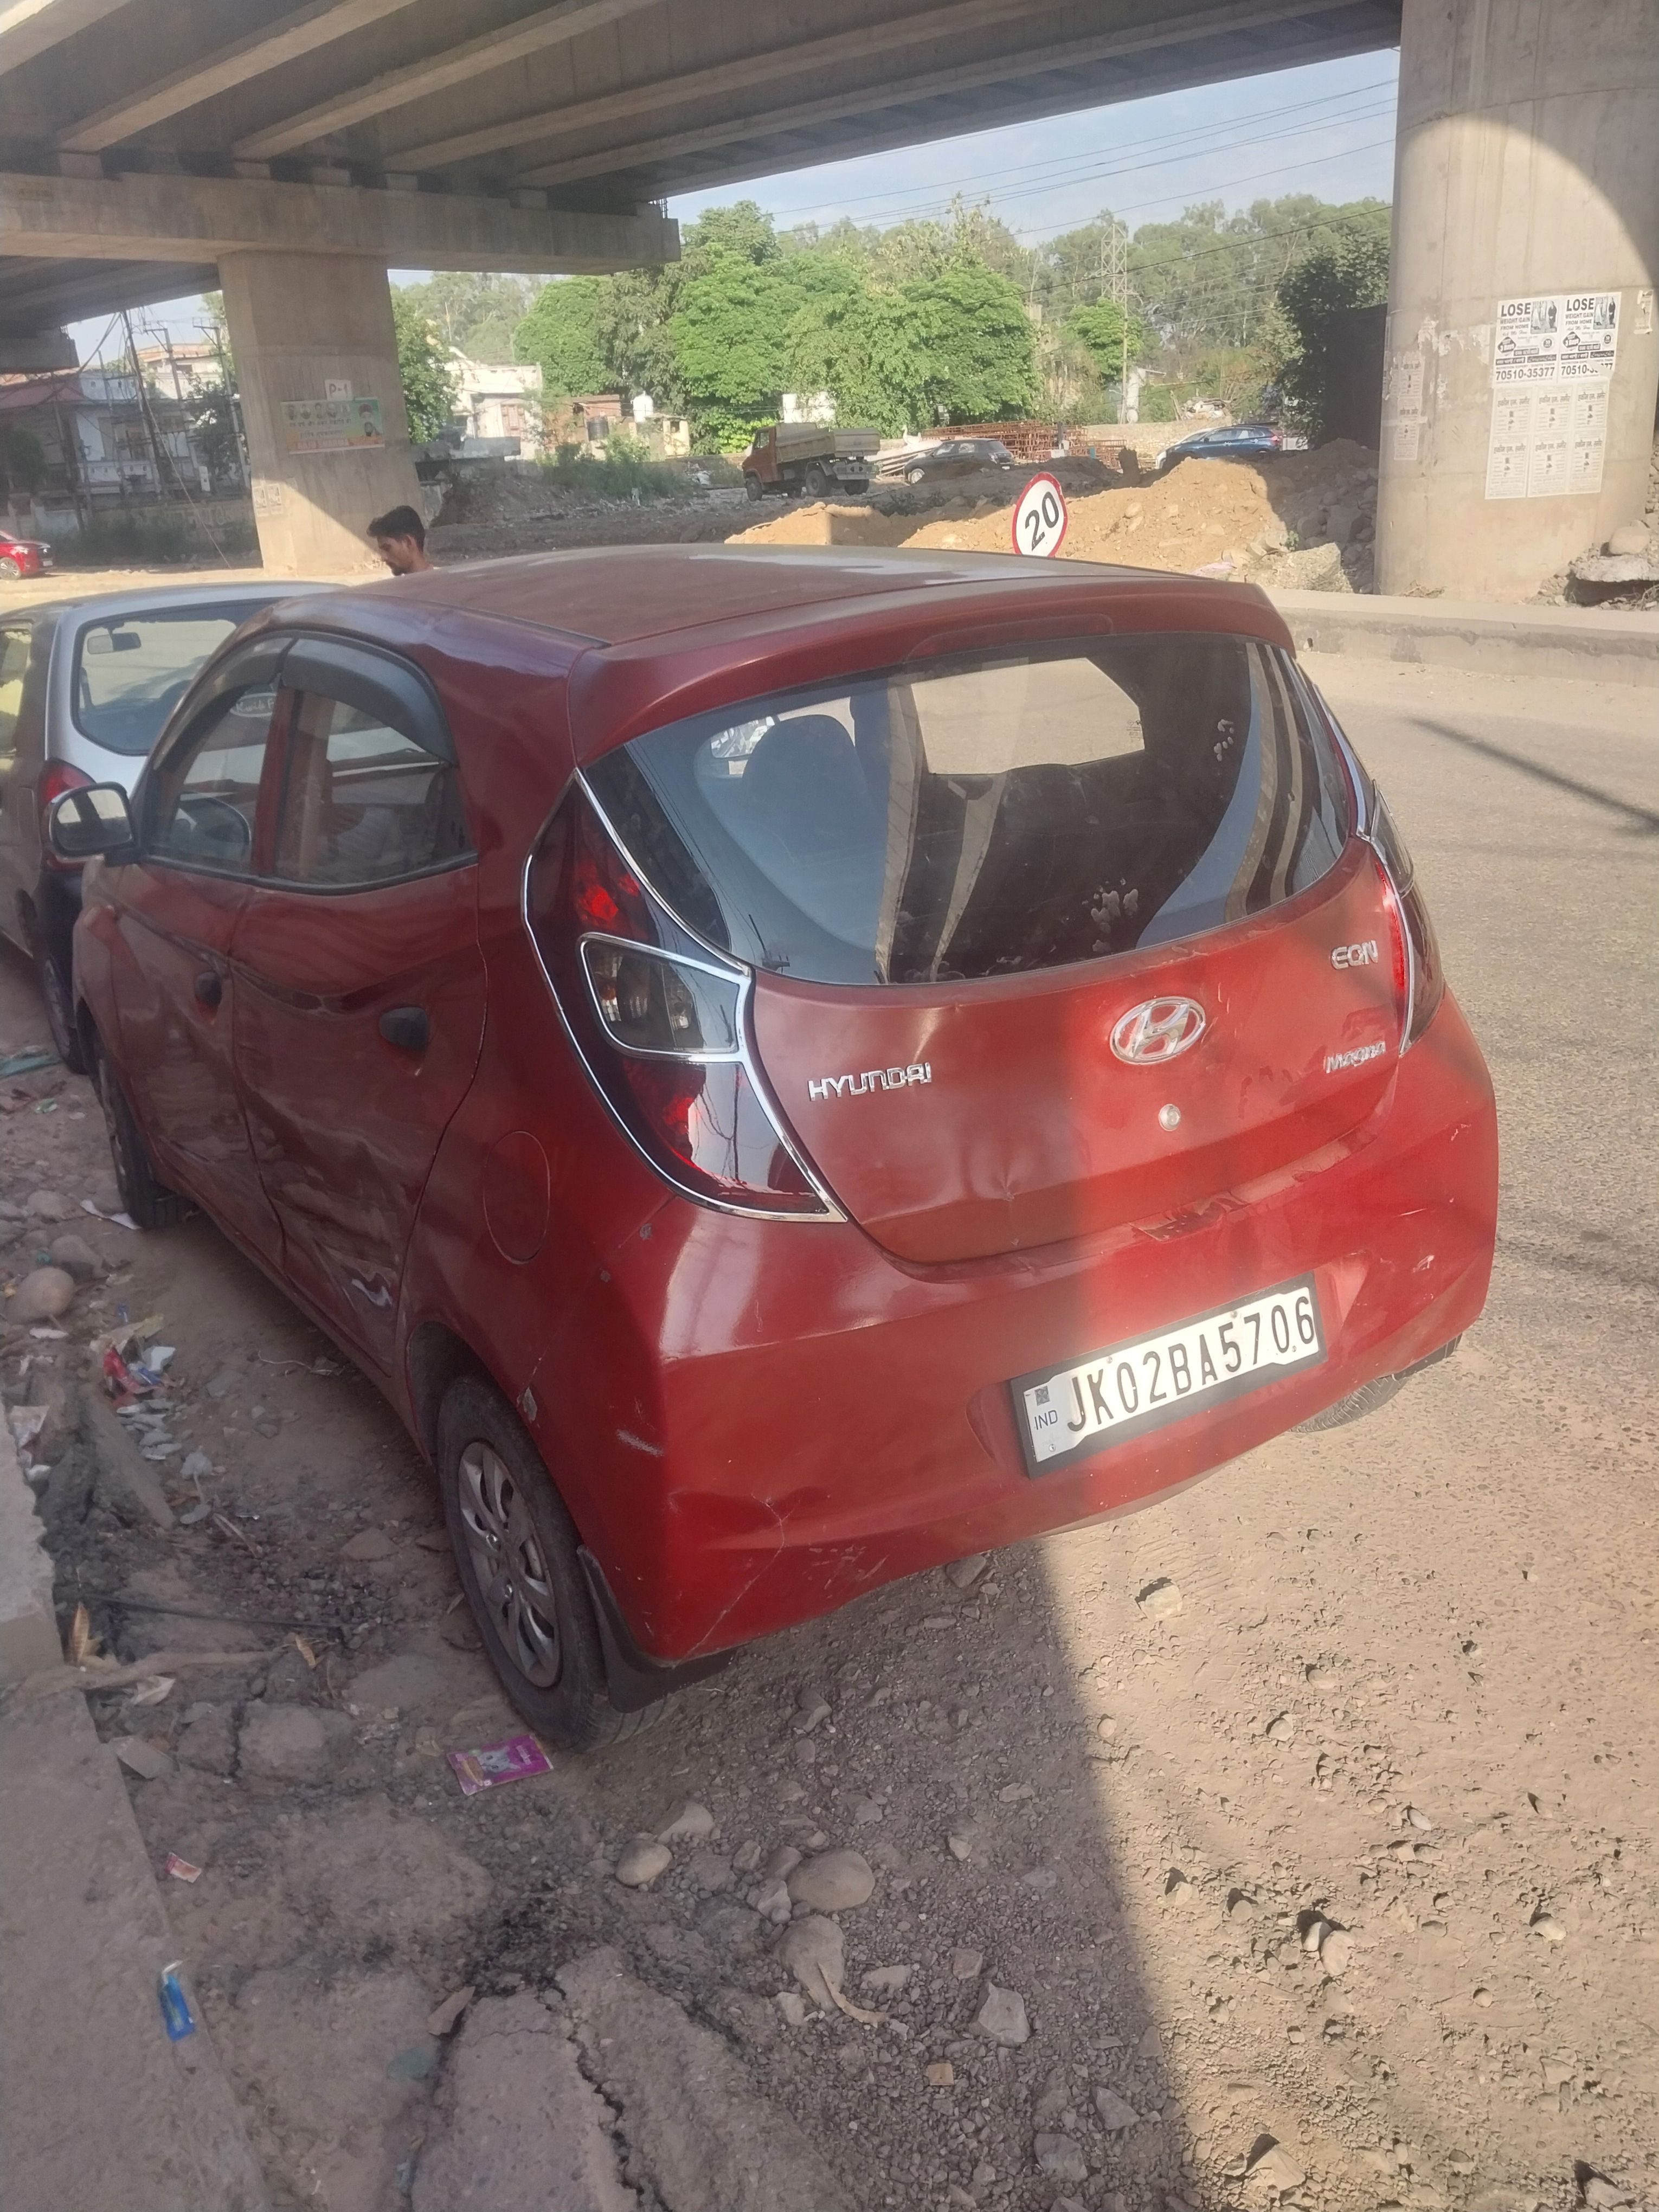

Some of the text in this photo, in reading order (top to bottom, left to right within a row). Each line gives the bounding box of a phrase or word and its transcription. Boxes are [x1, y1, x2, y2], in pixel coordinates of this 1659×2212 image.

[1501, 303, 1531, 317] LOSE
[1566, 298, 1594, 312] LOSE
[1496, 367, 1555, 381] 70510-35377
[1025, 491, 1059, 551] 20
[1331, 940, 1378, 969] EON
[1326, 1040, 1386, 1073] Magna
[808, 1062, 932, 1101] HYUNDAI
[1067, 1296, 1315, 1432] JK02BA5706
[1034, 1410, 1058, 1430] IND
